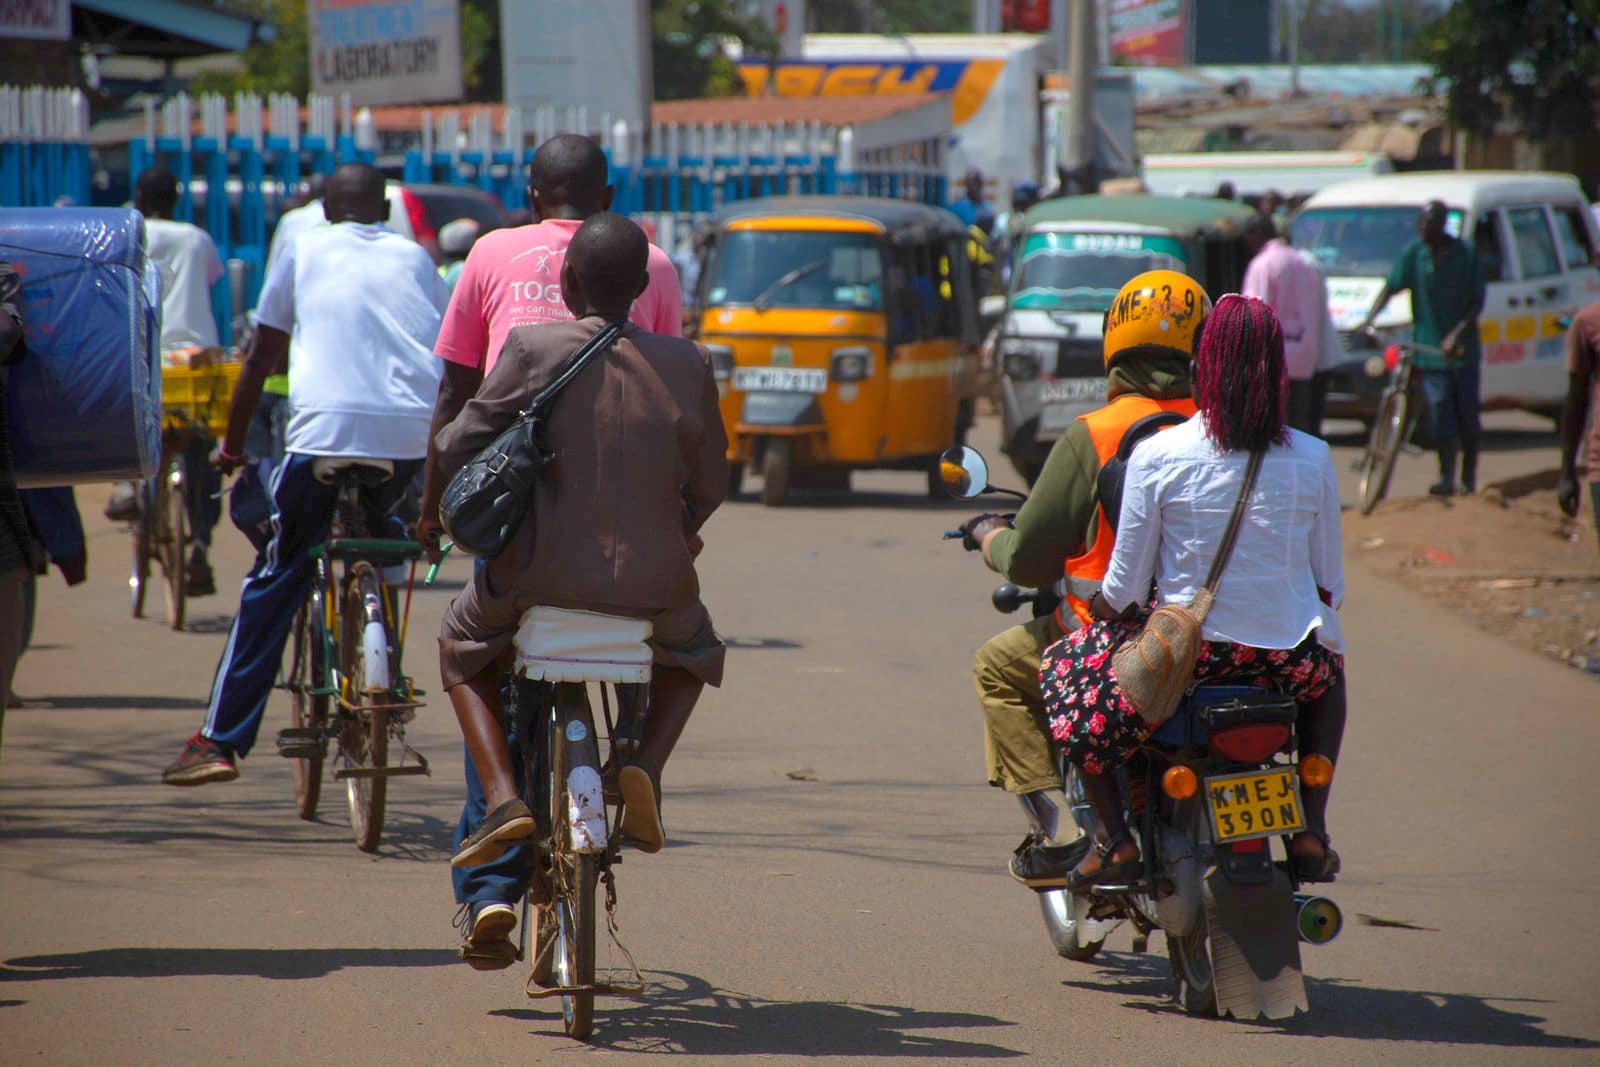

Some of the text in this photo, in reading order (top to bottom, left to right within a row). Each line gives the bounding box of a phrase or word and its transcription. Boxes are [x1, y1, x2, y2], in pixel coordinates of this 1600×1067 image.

[510, 280, 565, 305] TOG
[527, 304, 545, 315] can
[1213, 775, 1290, 808] KMEJ
[1220, 803, 1295, 834] 390N
